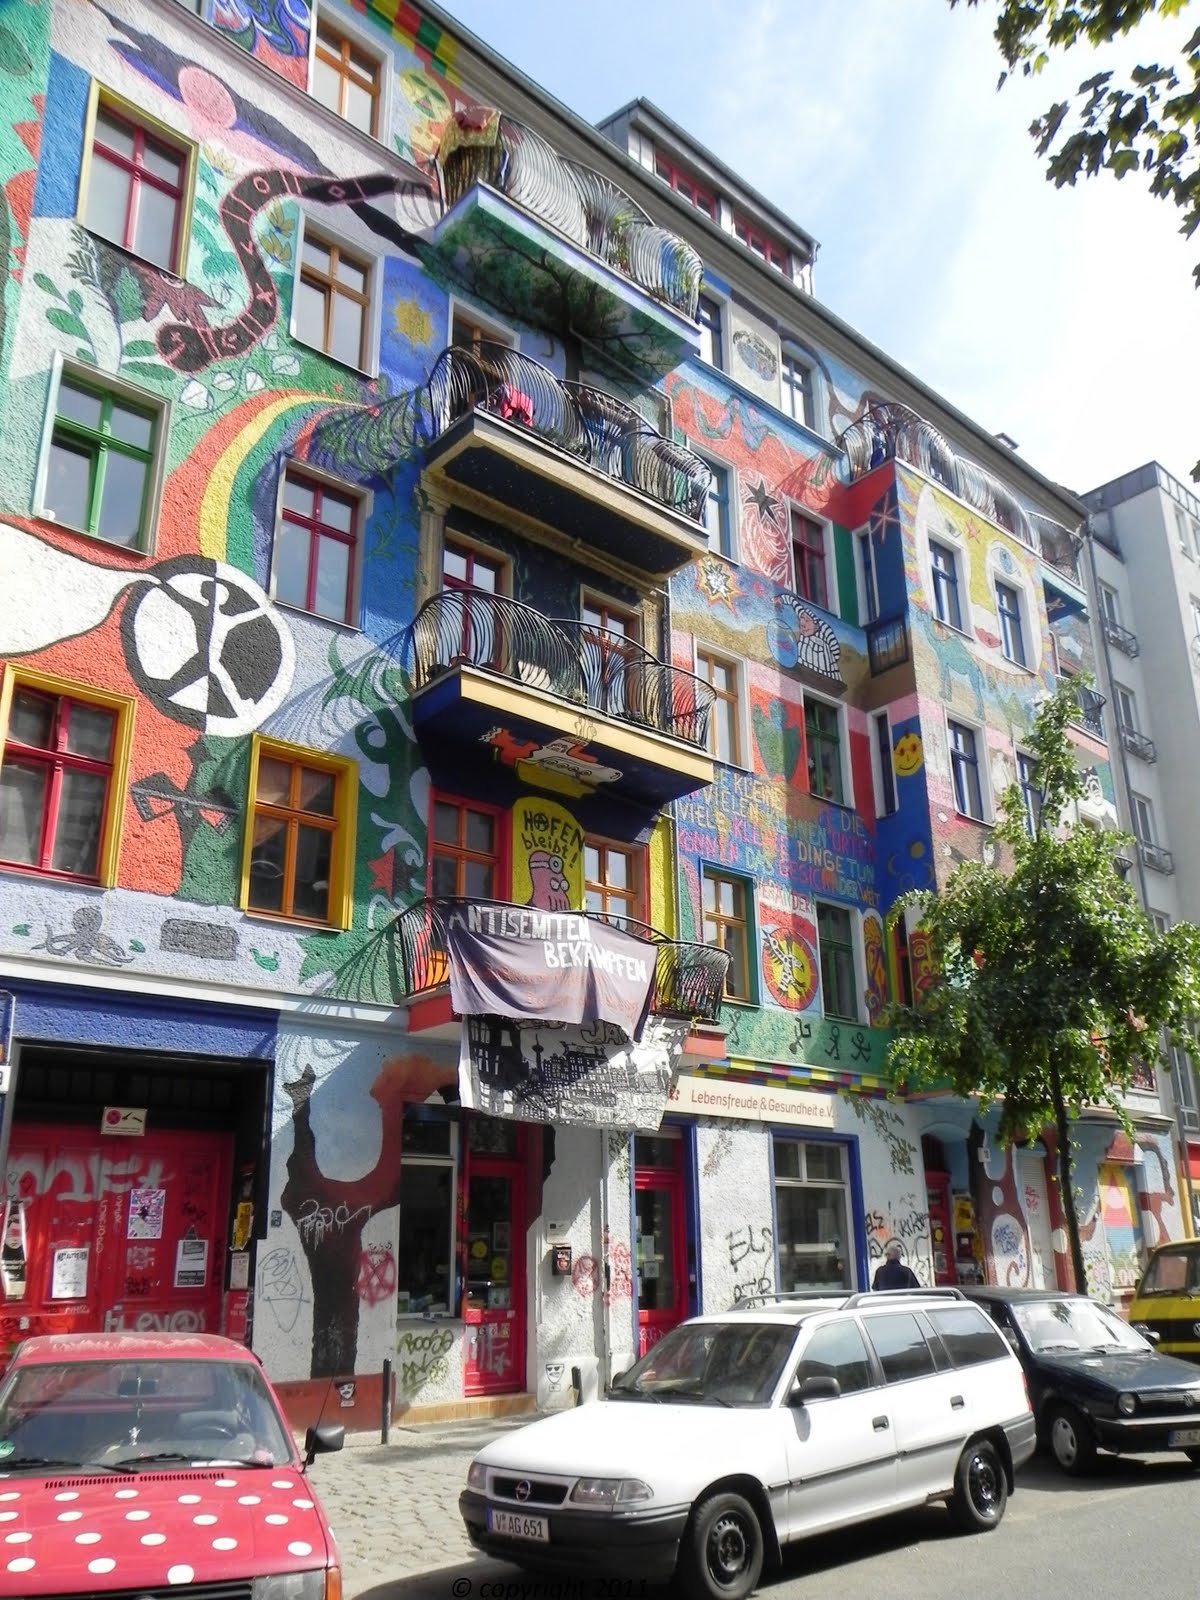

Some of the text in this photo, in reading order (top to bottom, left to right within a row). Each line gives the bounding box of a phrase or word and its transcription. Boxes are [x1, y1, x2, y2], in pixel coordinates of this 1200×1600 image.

[840, 810, 866, 837] DIE
[797, 838, 846, 876] DINGE
[846, 857, 876, 885] TUN
[449, 904, 590, 942] ANTISEMITEN
[691, 1089, 758, 1110] Lebensfreude
[760, 1097, 768, 1110] &
[768, 1100, 818, 1118] Gesundheit
[495, 1513, 545, 1539] V AG 651
